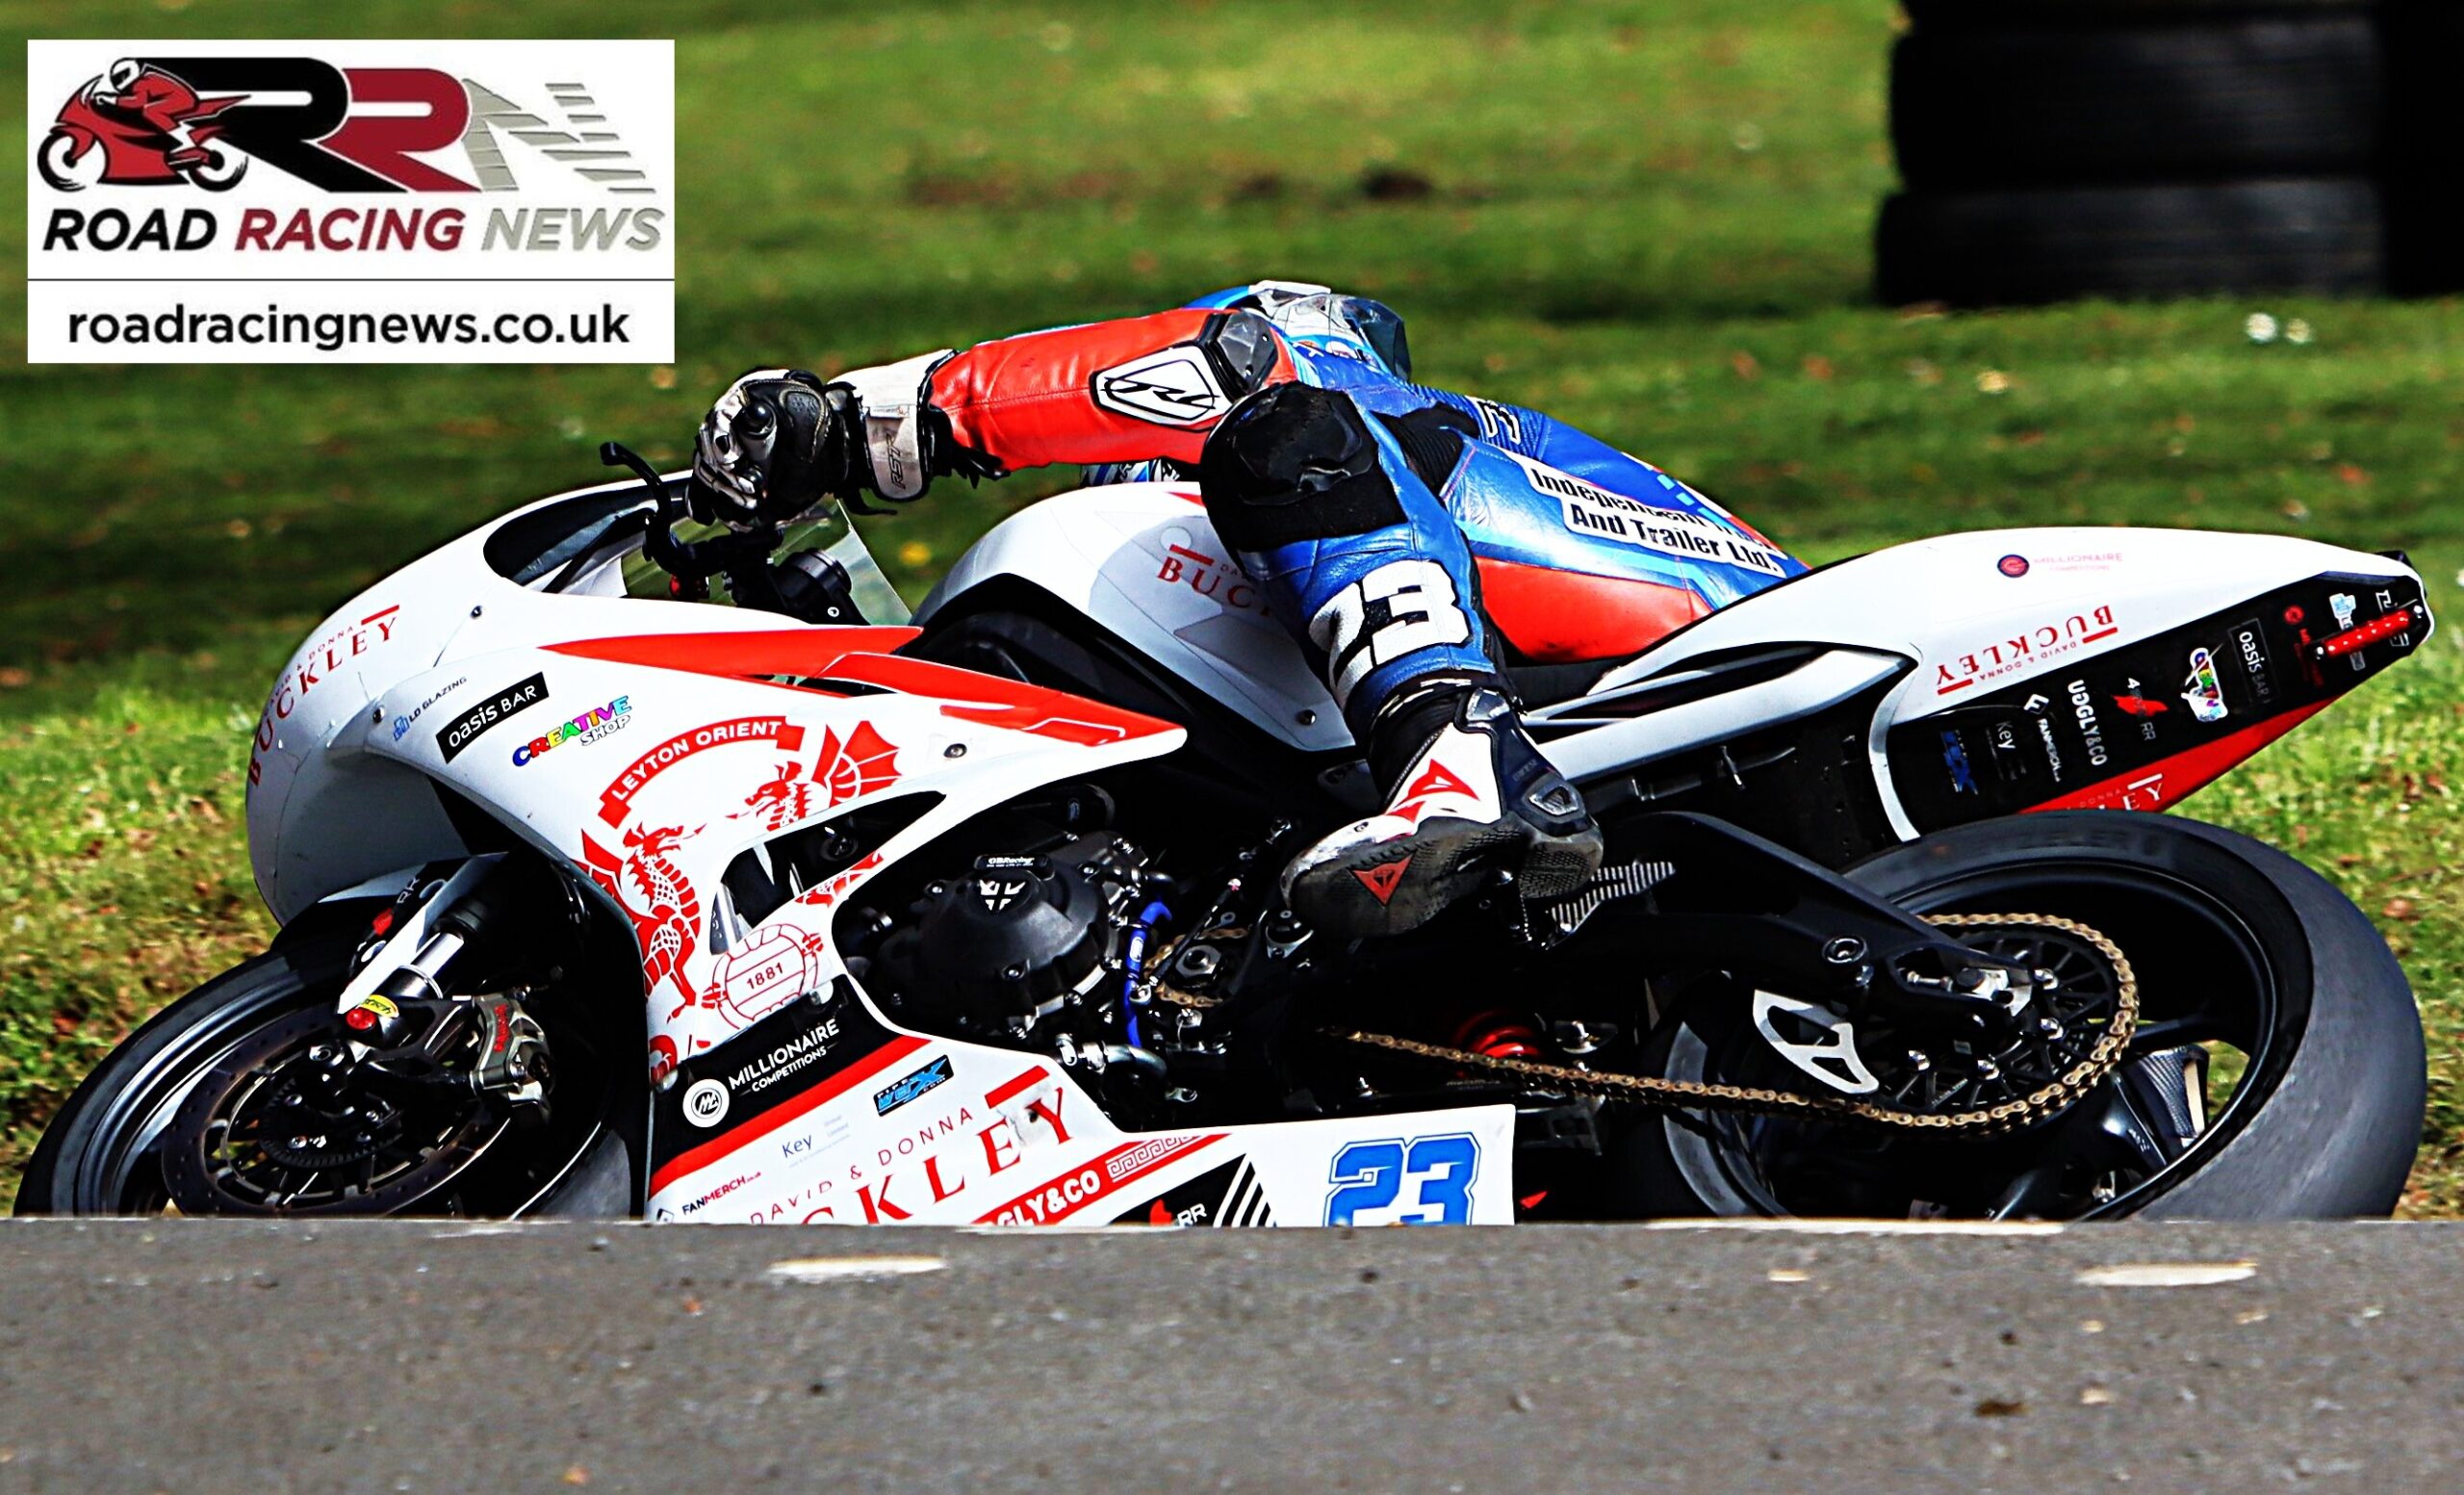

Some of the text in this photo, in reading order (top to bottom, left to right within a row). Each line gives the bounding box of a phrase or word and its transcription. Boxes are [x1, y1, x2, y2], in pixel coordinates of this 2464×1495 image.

[1571, 503, 1628, 535] And
[1630, 519, 1722, 556] Trailer
[1727, 539, 1779, 572] Ltd.
[308, 625, 353, 660] DONNA
[1937, 605, 2115, 685] BUCKLEY
[2040, 640, 2077, 660] DAVID
[2239, 631, 2266, 674] oasis
[422, 676, 468, 710] GLAZING
[1980, 660, 2022, 681] DONNA
[247, 616, 398, 786] BUCKLEY
[449, 684, 537, 747] oasis BAR
[512, 695, 632, 767] CREATIVE
[580, 714, 631, 747] SHOP
[1996, 721, 2016, 751] Key
[611, 721, 783, 800] LEYTON ORIENT
[747, 962, 783, 990] 1881
[729, 1018, 840, 1091] MILLIONAIRE
[751, 1044, 827, 1093] COMPETITIONS
[750, 1180, 833, 1224] DAVID
[850, 1164, 862, 1180] &
[877, 1107, 973, 1167] DONNA
[782, 1135, 811, 1158] Key
[1324, 1132, 1480, 1226] 23
[1177, 1202, 1208, 1226] RR
